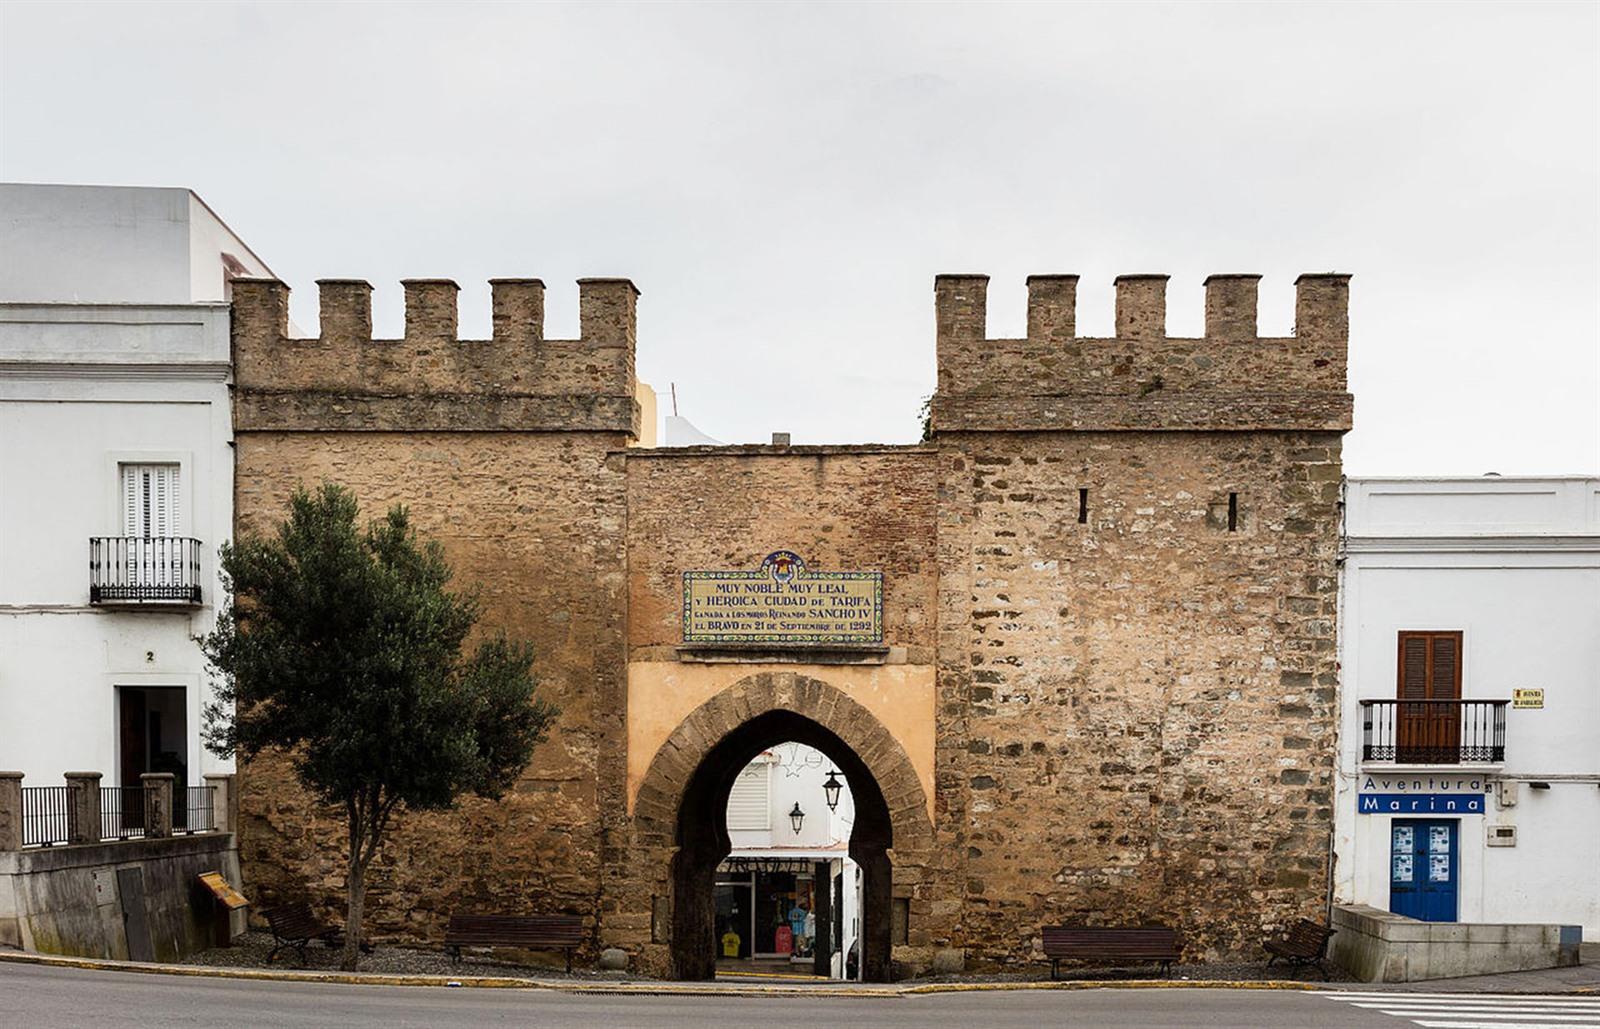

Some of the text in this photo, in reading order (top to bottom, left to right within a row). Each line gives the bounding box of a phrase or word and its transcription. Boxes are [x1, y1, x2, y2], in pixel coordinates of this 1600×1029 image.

[716, 583, 740, 593] MUY
[745, 584, 784, 593] NOBLE
[789, 584, 813, 593] MUY
[707, 596, 757, 606] HEROICA
[765, 596, 807, 606] CIUDAD
[831, 596, 870, 606] TARIFA
[809, 609, 855, 618] SANCHO
[859, 609, 870, 618] IV
[708, 621, 739, 630] BRAVO
[754, 621, 764, 630] 21
[835, 623, 845, 631] DE
[850, 621, 872, 631] 1292
[147, 651, 154, 662] 2
[1364, 777, 1480, 790] Aventura
[1364, 797, 1478, 810] Marina
